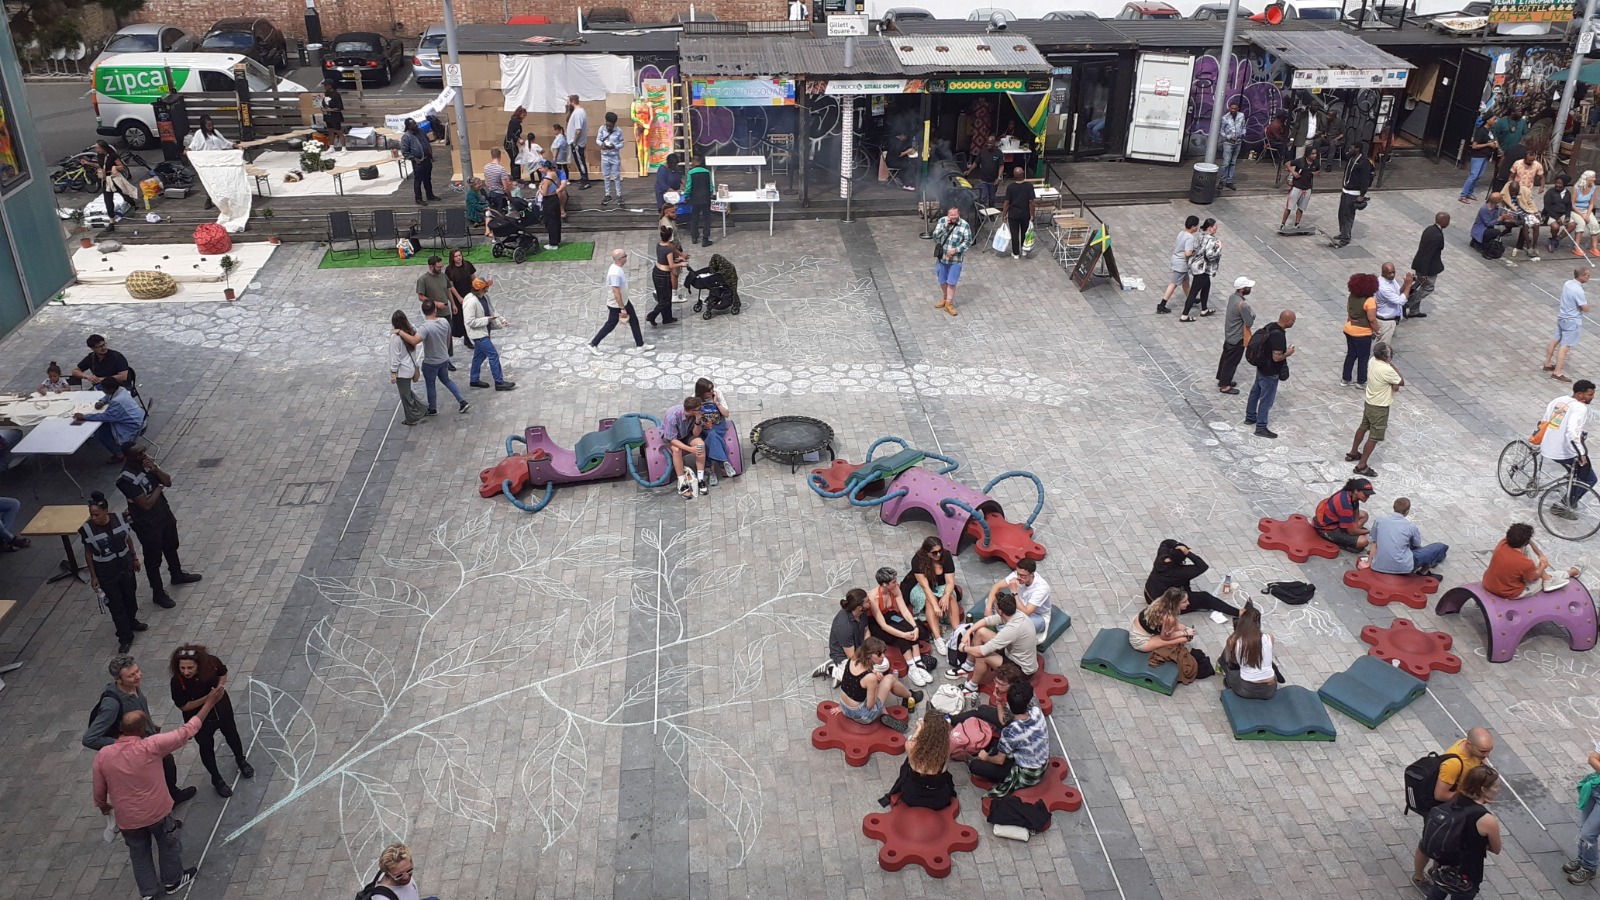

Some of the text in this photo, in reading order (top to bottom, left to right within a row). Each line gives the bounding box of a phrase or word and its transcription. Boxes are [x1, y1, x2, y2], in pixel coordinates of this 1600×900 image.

[1517, 4, 1548, 12] COFFEE
[1488, 10, 1573, 22] KAFFA LIVE
[102, 69, 172, 95] zipca
[754, 87, 789, 97] SQUARE
